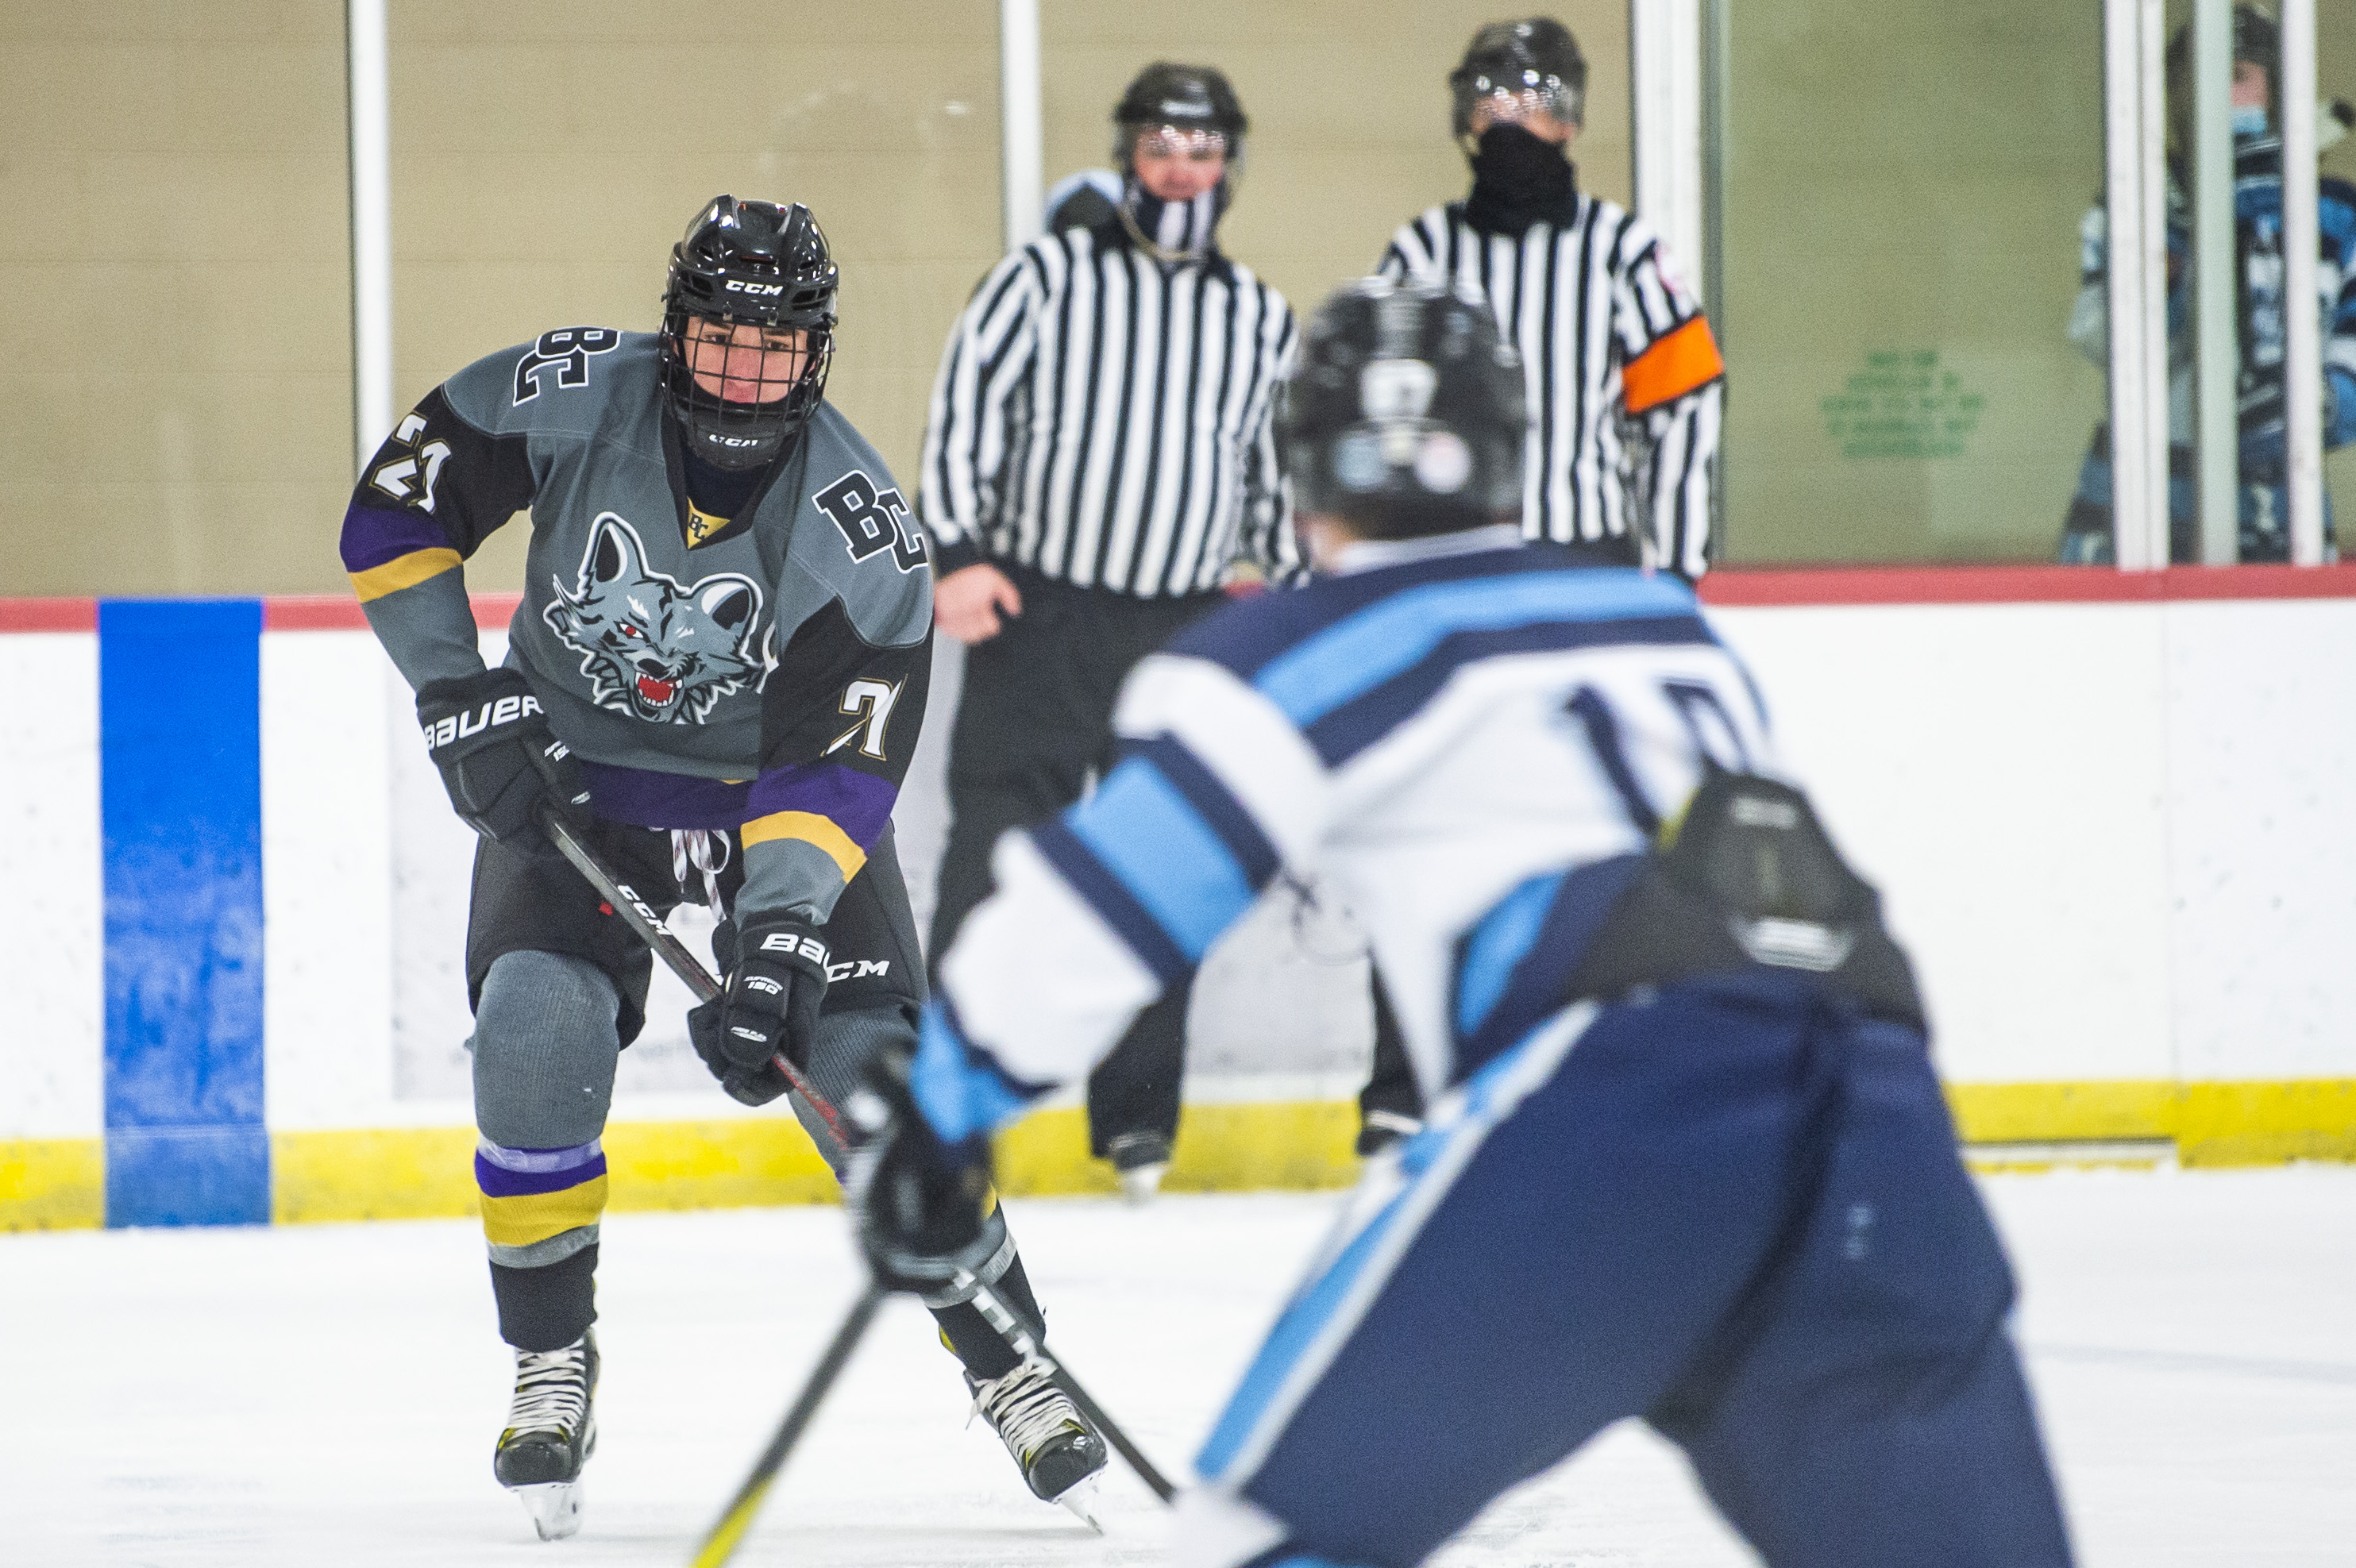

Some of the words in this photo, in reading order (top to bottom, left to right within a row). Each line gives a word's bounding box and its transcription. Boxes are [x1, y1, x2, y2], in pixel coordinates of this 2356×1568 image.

[725, 279, 784, 296] CCM
[513, 326, 623, 407] BC
[812, 469, 929, 574] BC
[617, 884, 673, 936] CCM
